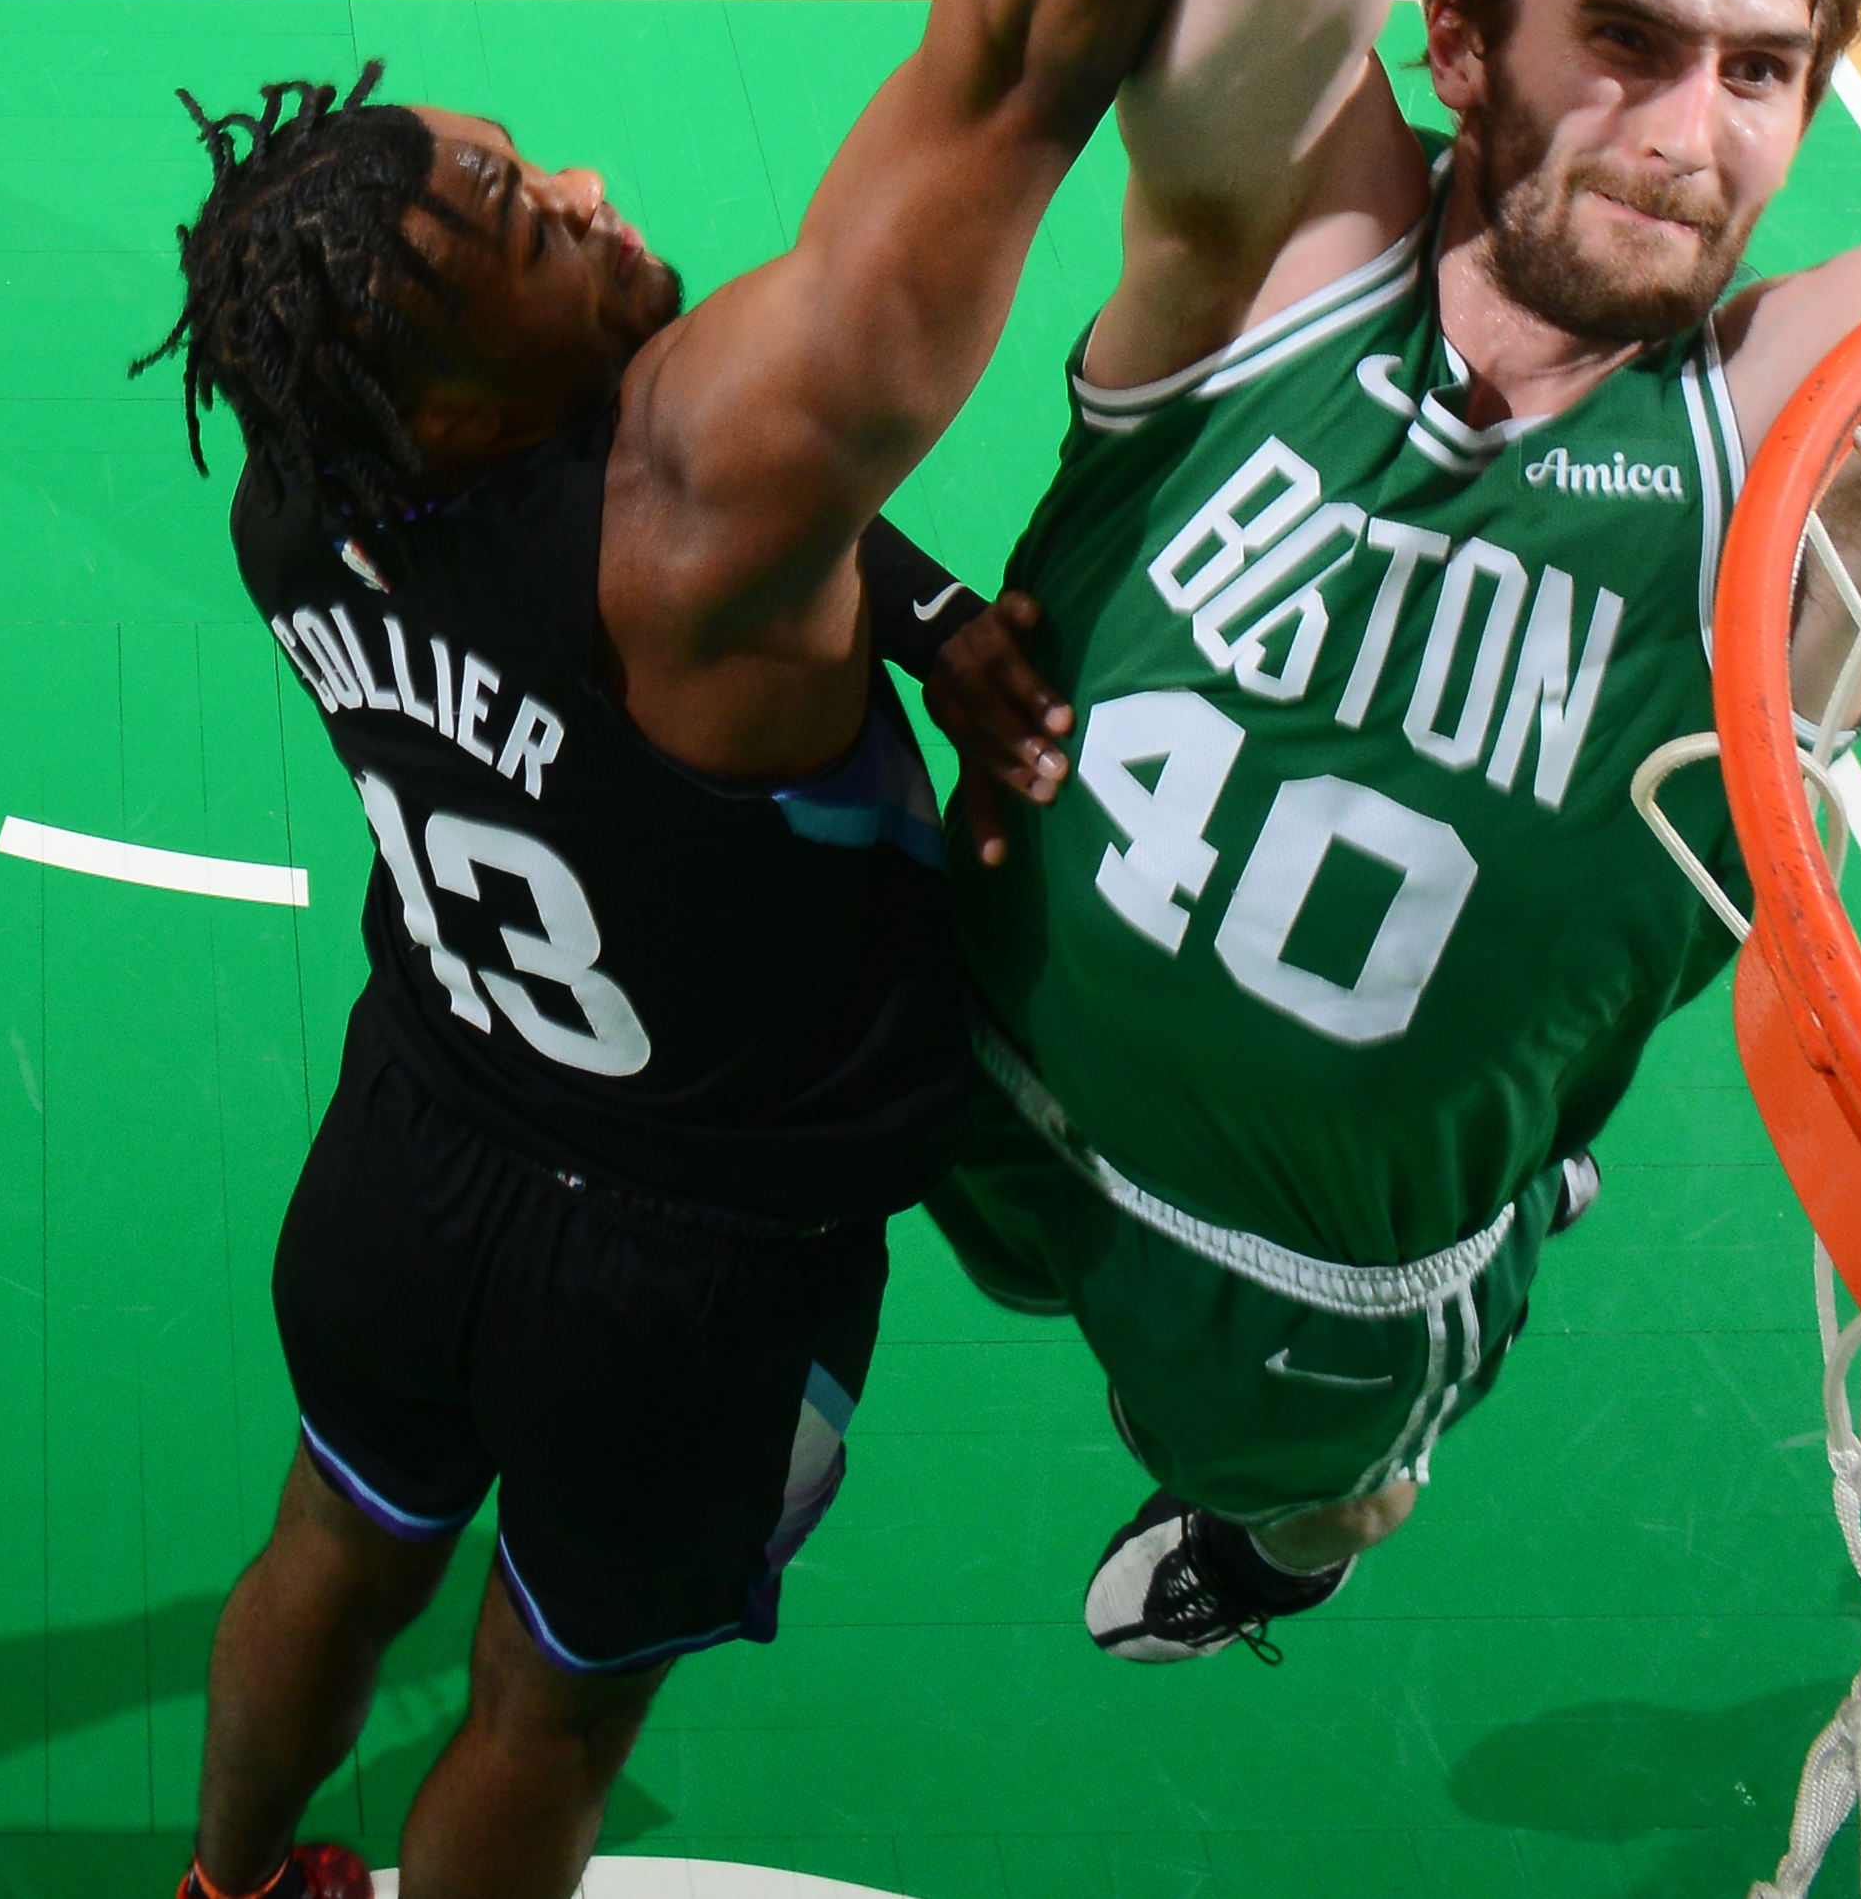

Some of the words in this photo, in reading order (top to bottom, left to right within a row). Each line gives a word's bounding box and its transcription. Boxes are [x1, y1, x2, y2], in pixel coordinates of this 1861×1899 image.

[1524, 445, 1685, 502] Amica
[354, 769, 652, 1077] 13
[1077, 685, 1480, 1049] 40
